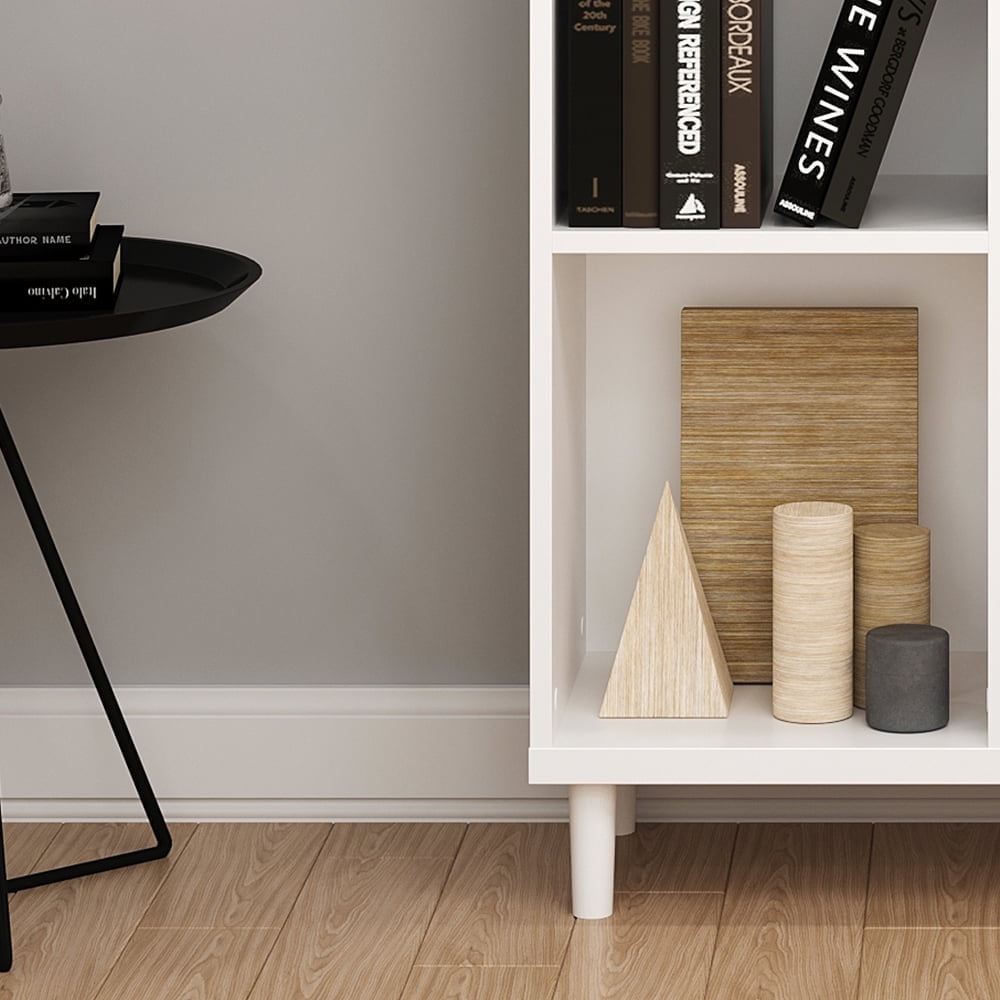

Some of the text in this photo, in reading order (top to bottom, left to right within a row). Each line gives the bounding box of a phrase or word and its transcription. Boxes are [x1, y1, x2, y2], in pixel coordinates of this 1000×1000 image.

[583, 11, 608, 20] 20th
[632, 15, 650, 37] BIKE
[574, 22, 617, 34] Century
[632, 39, 650, 64] BOOK
[878, 39, 906, 99] BERGDORF
[677, 34, 702, 155] REFERENCED
[798, 47, 865, 181] WINES
[857, 97, 886, 158] GOODMAN
[734, 163, 747, 213] ASSOULINE
[778, 199, 816, 220] ASSOULINE
[0, 235, 72, 245] UTHOR NAME
[27, 286, 97, 300] Italo Calvino
